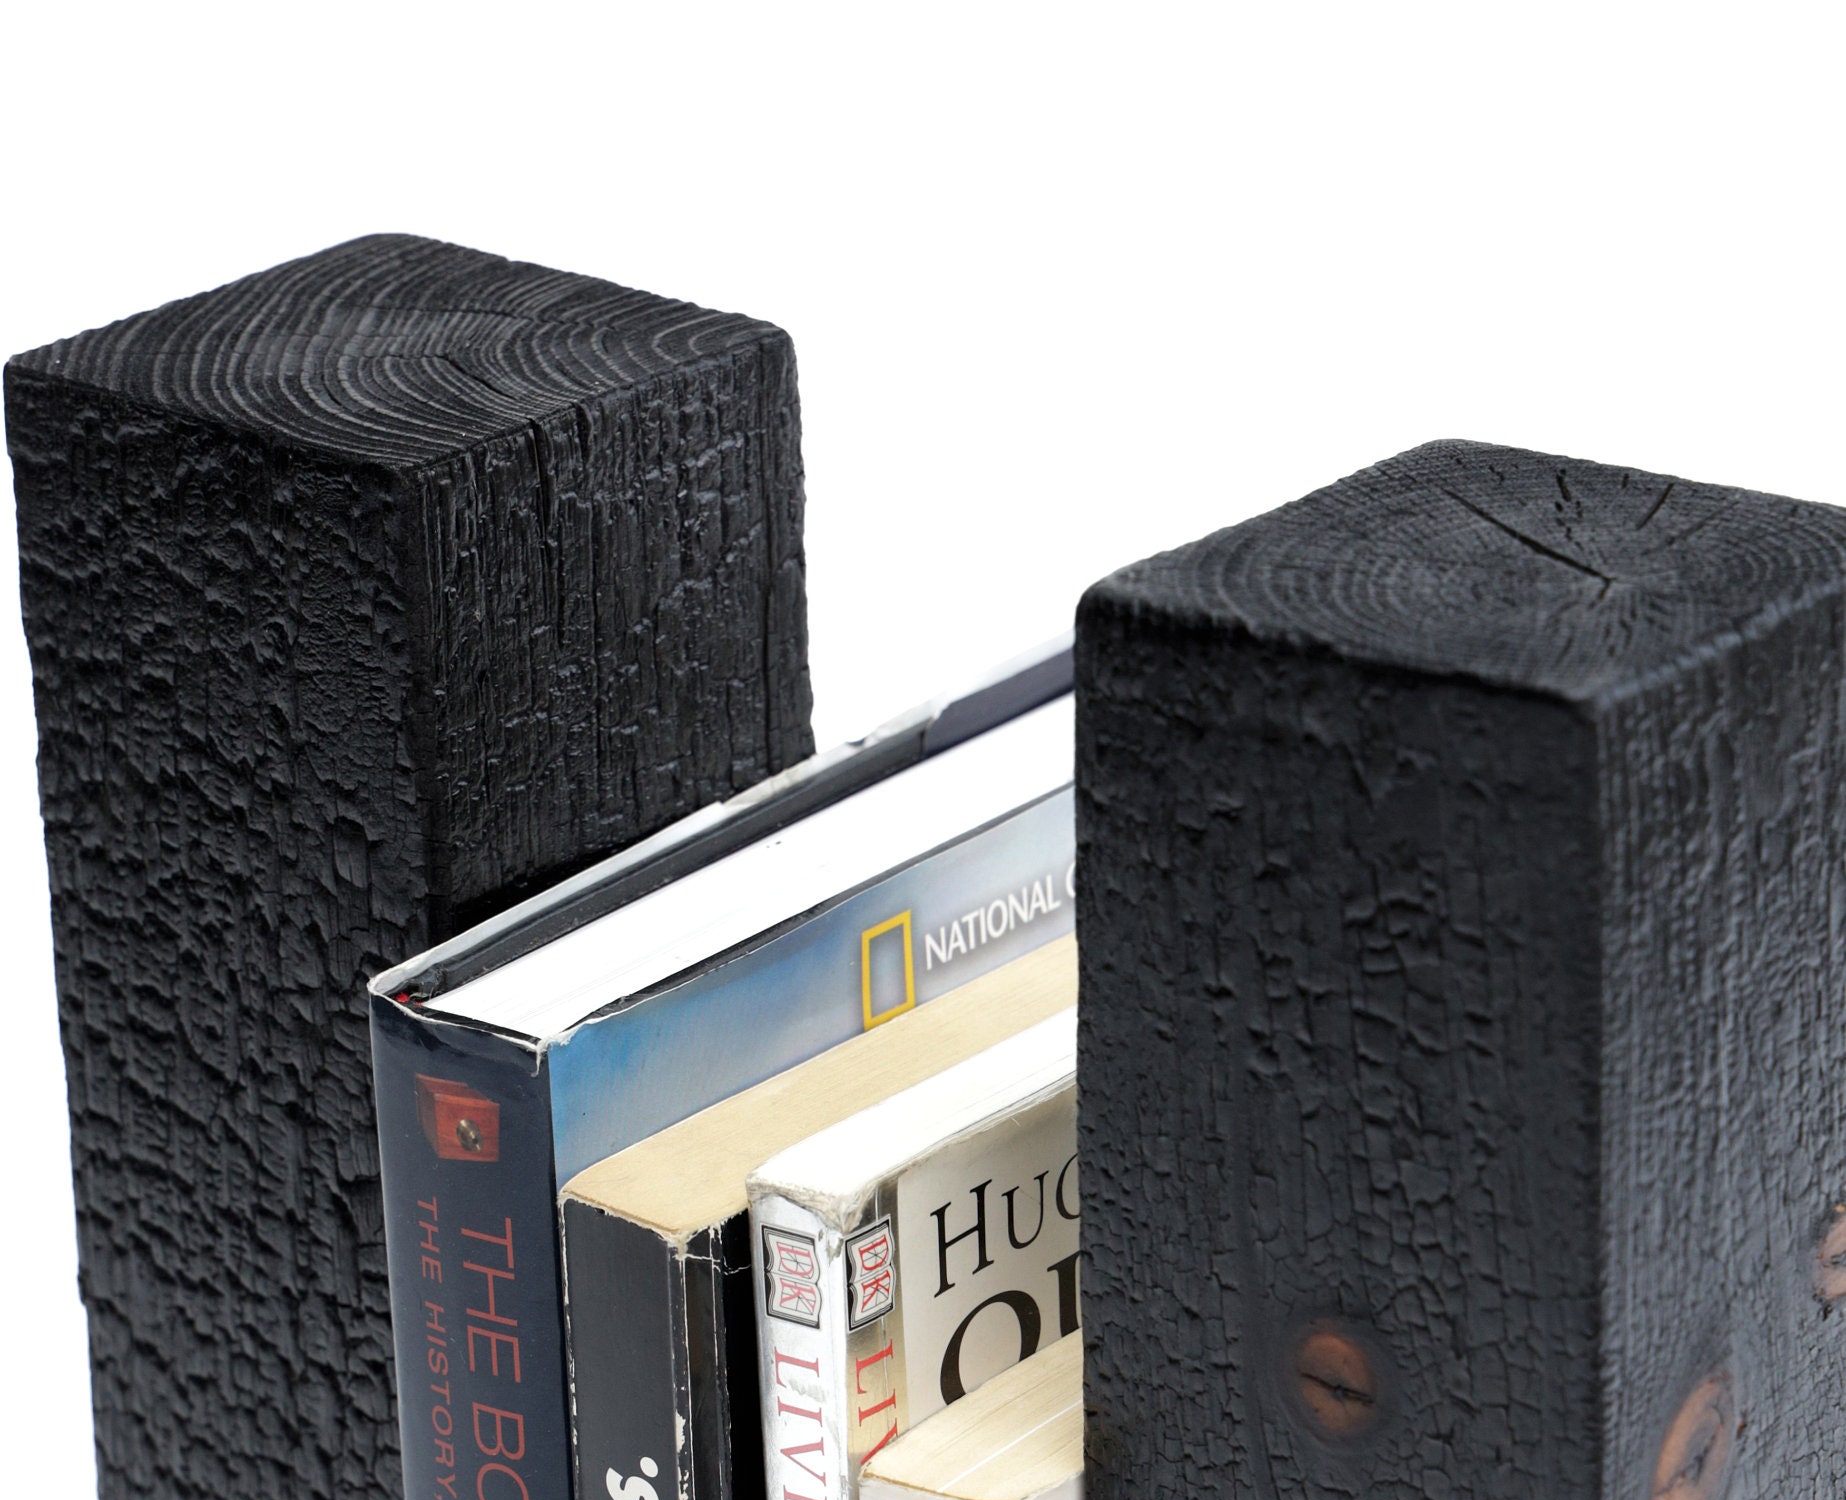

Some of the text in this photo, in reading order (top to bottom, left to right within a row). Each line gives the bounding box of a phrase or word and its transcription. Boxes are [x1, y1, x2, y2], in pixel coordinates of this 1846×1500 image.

[925, 875, 1061, 970] NATIONAL
[417, 1198, 443, 1283] THE
[776, 1242, 816, 1312] DK
[858, 1234, 891, 1312] DK
[461, 1217, 522, 1384] THE
[423, 1301, 457, 1500] HISTORY,
